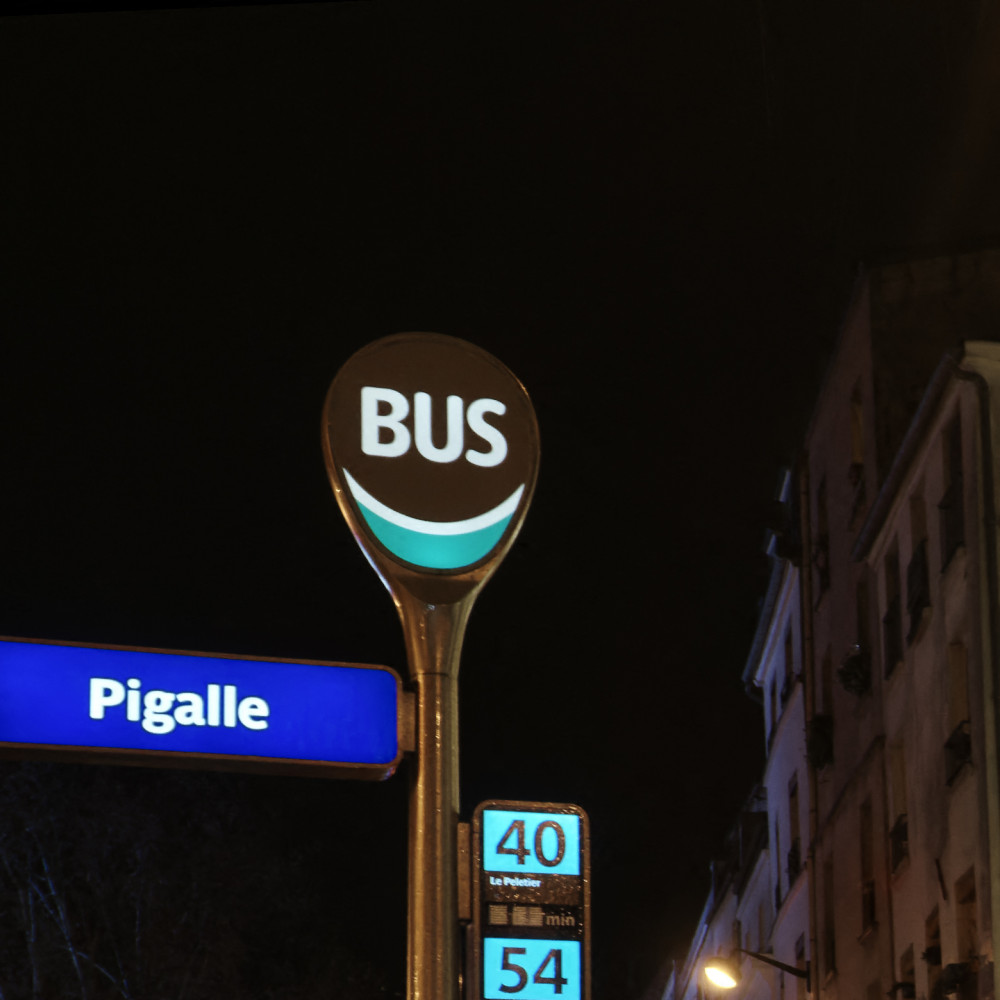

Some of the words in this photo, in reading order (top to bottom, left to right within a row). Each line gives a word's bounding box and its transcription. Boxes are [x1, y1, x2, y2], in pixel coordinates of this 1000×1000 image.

[361, 386, 508, 467] BUS
[89, 677, 270, 735] Pigalle
[496, 819, 566, 868] 40
[489, 876, 502, 886] Le
[503, 877, 541, 887] Peletier
[546, 911, 575, 926] min
[498, 946, 568, 994] 54
